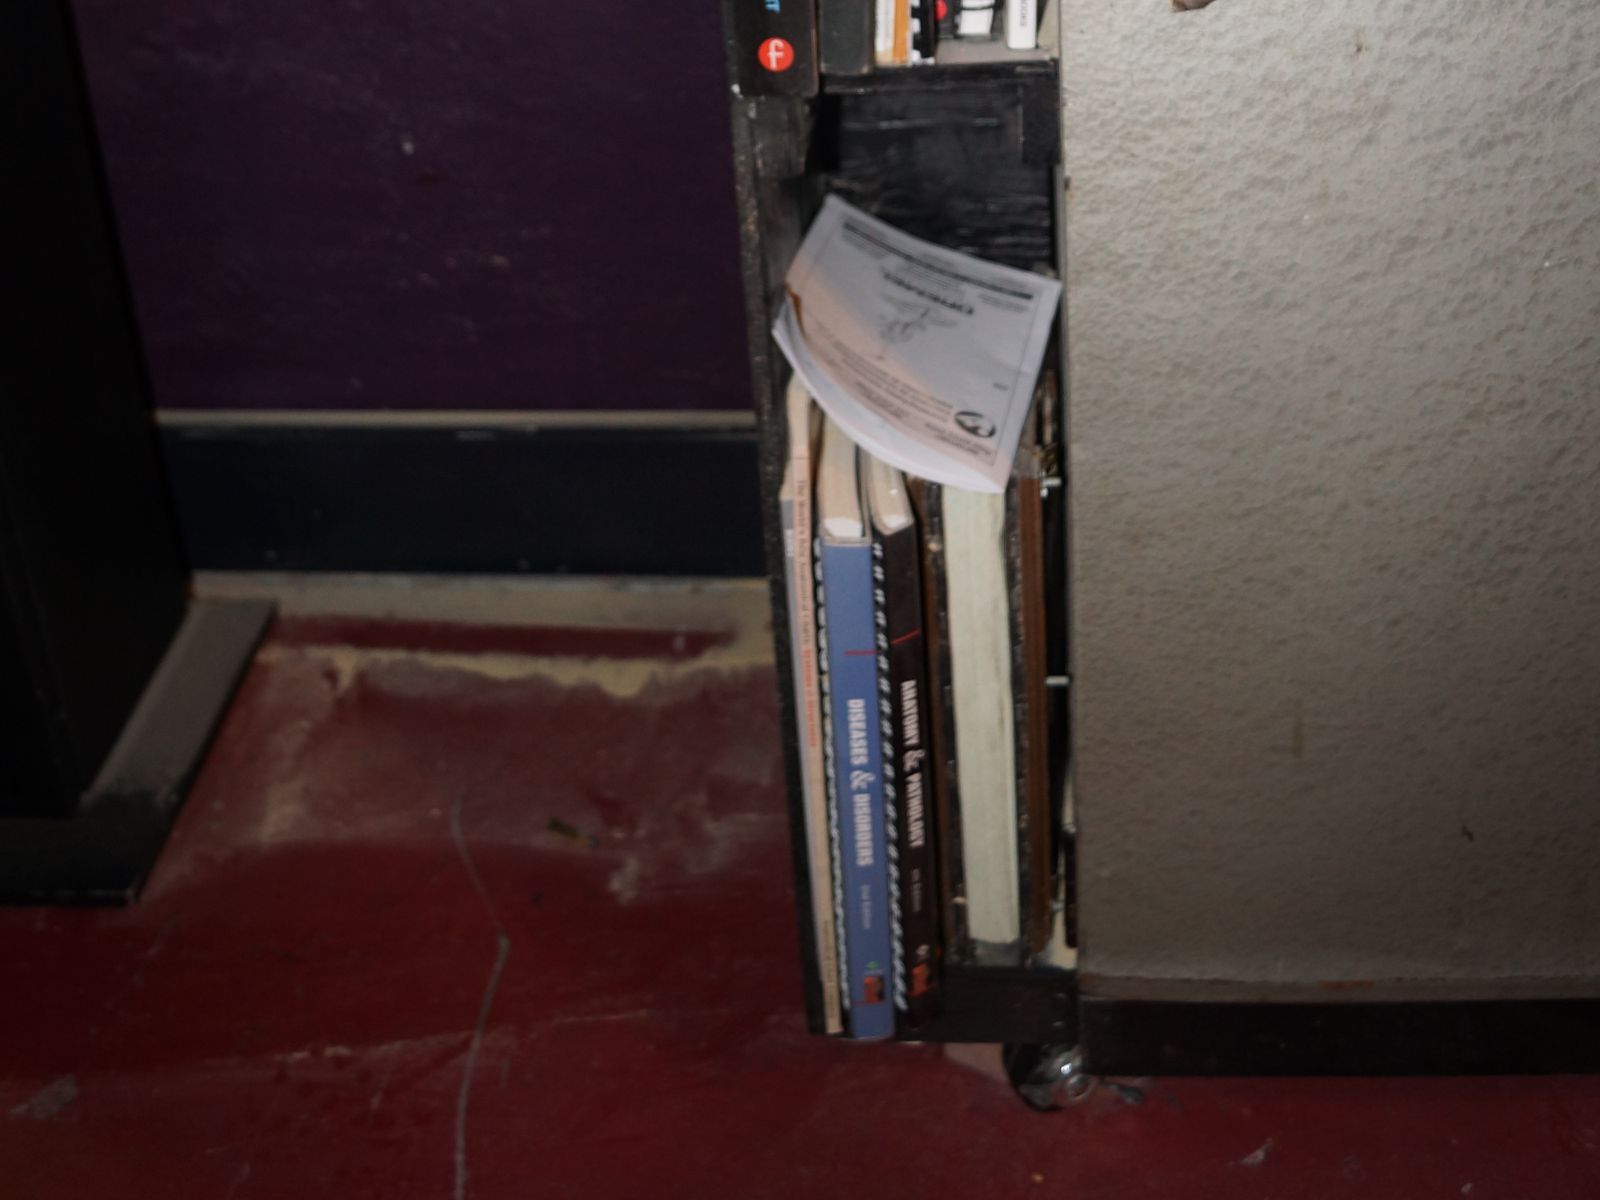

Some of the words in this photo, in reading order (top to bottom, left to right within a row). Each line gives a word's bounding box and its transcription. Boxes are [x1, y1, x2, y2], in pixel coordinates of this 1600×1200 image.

[847, 699, 869, 766] DISEASES
[899, 679, 921, 745] ANATOMY
[850, 770, 876, 791] &
[903, 749, 926, 772] &
[853, 793, 874, 867] DISORDERS
[905, 773, 926, 848] PATHOLOGY
